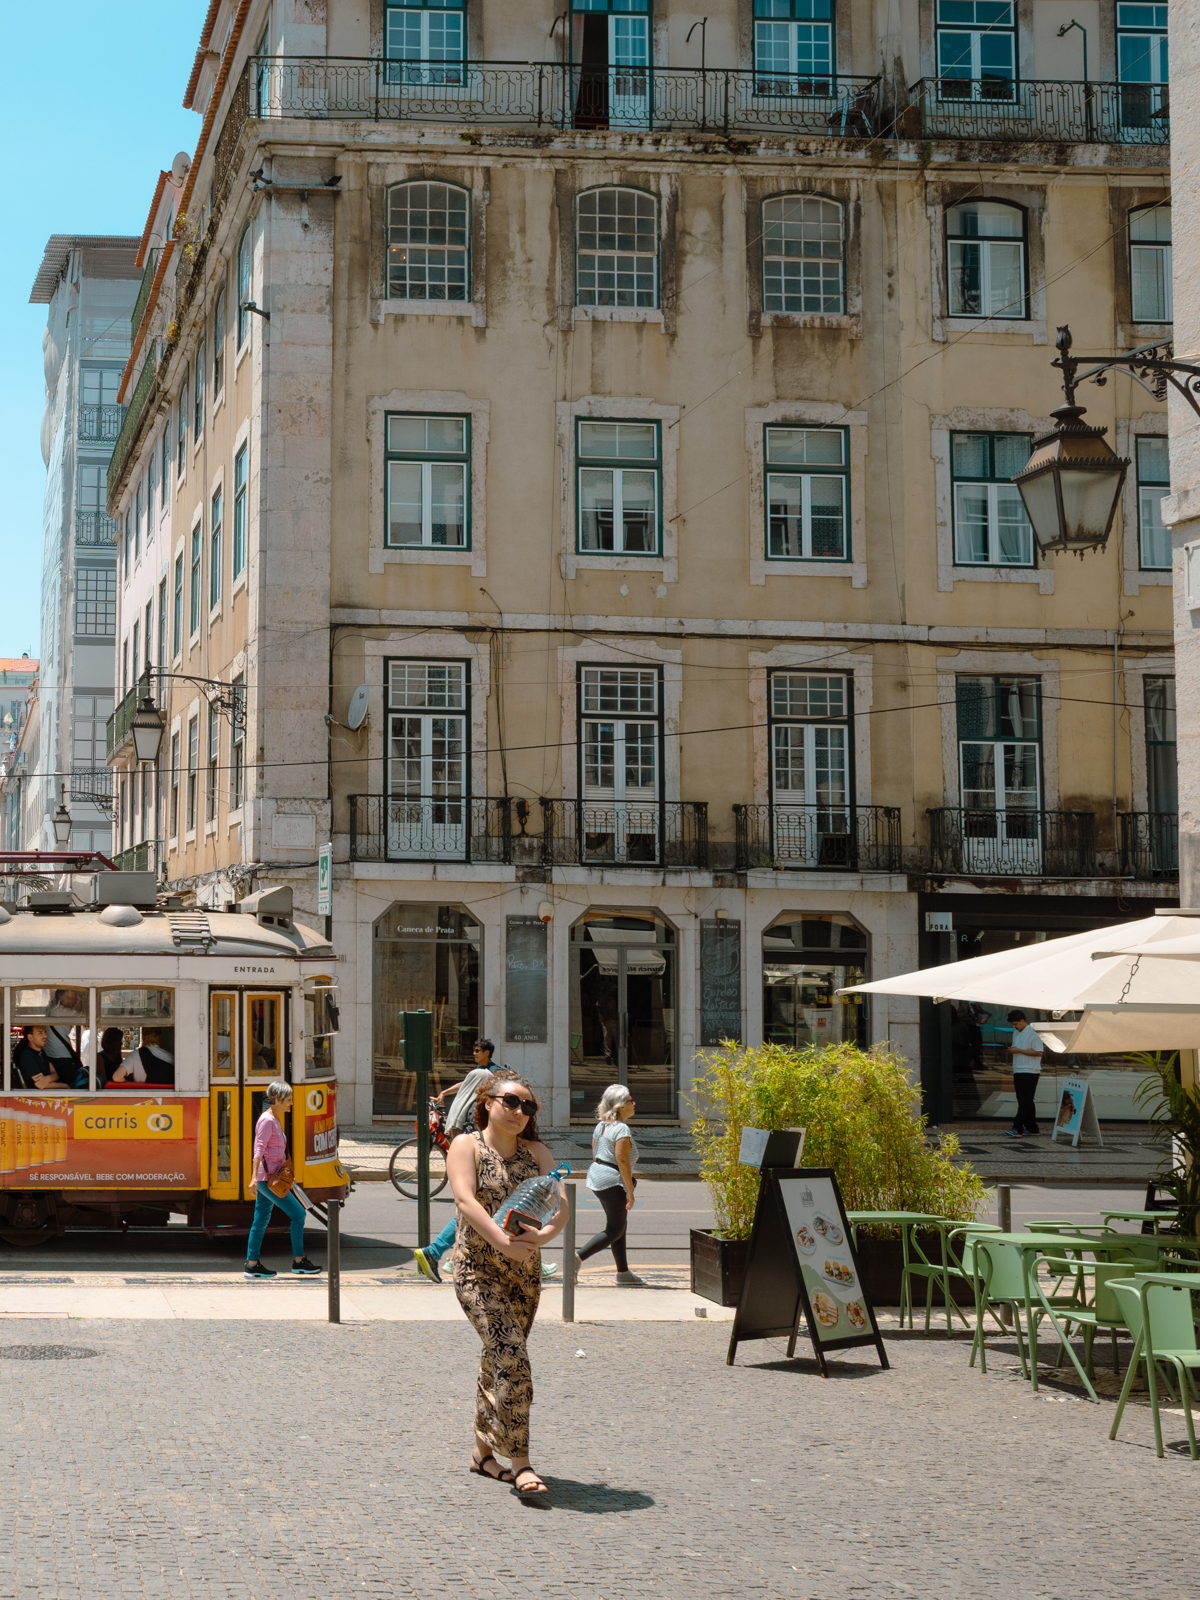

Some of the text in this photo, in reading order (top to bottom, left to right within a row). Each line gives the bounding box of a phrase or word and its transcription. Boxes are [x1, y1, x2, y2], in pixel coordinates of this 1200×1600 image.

[397, 925, 422, 934] Caneca
[436, 926, 455, 934] Prata
[84, 1112, 138, 1129] carris
[313, 1131, 328, 1153] COM
[29, 1171, 187, 1182] SÊ RESPONSÁVEL. BEBE COM MODERAÇÃO.
